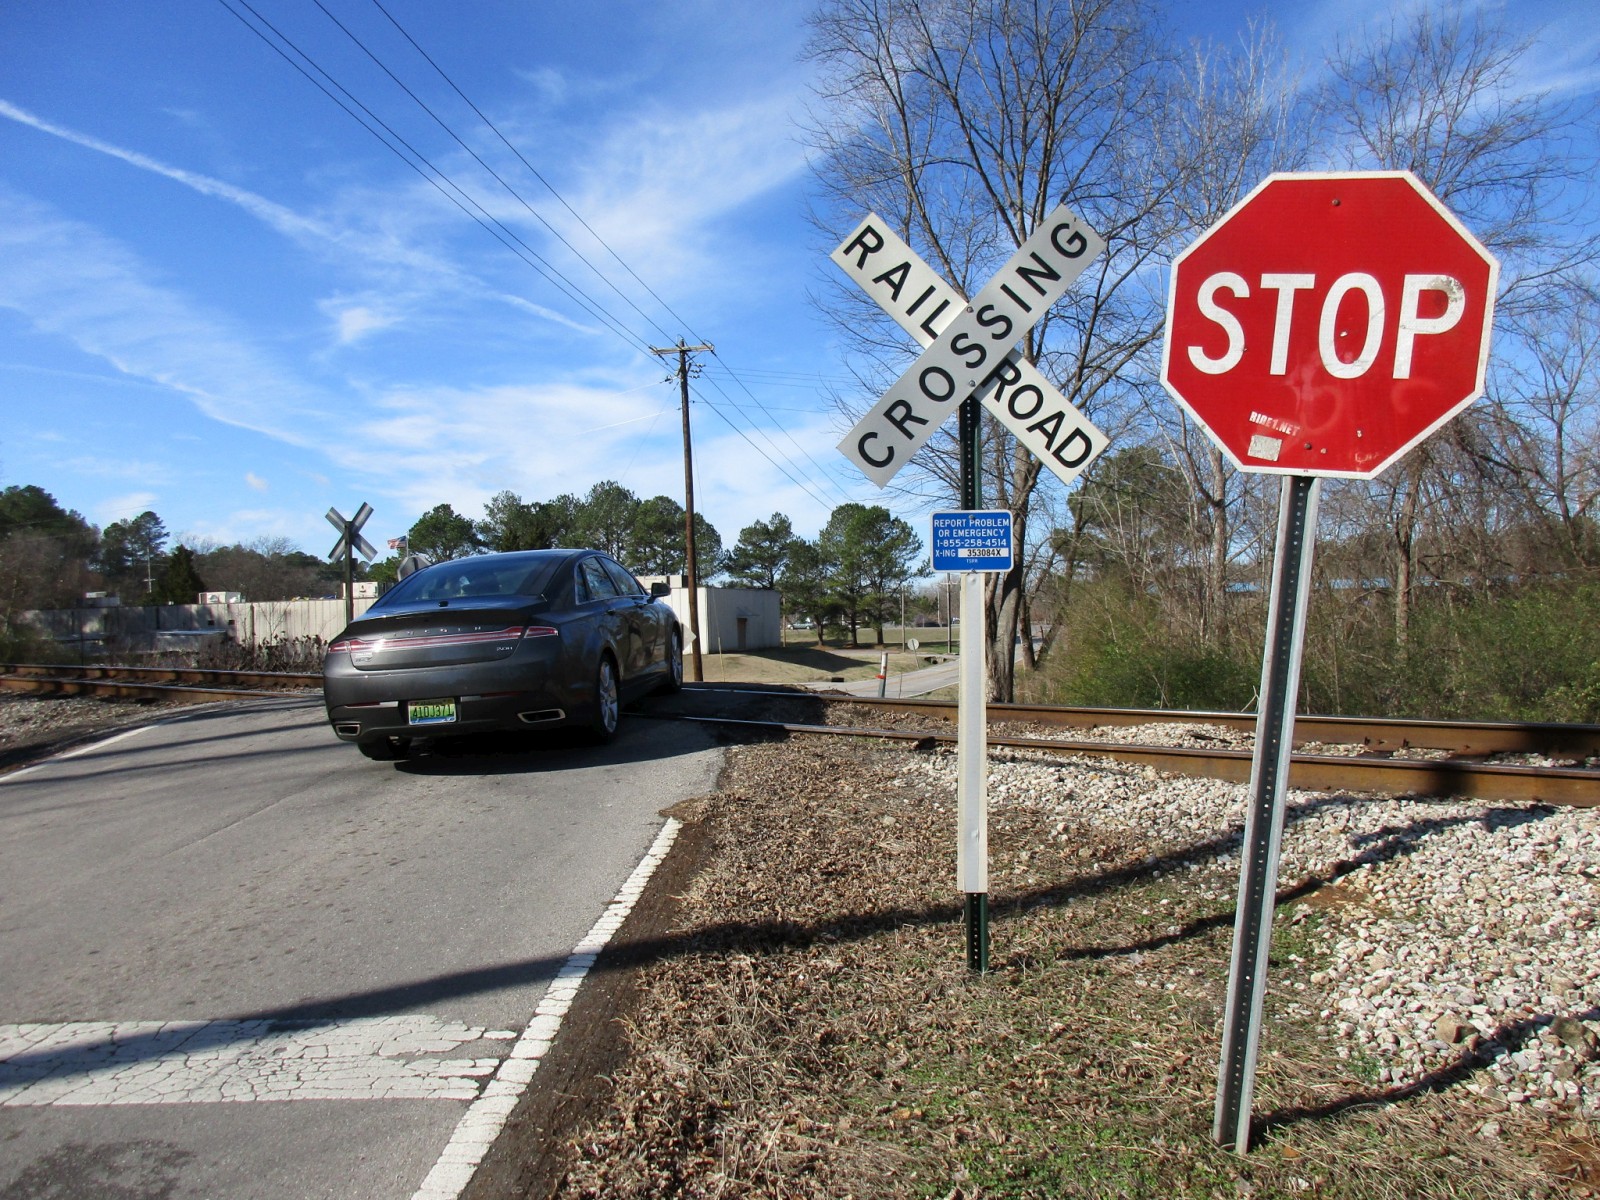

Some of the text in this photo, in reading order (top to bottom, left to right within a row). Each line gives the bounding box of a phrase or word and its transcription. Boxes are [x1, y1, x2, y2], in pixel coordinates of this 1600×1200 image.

[843, 225, 950, 340] RAIL
[858, 222, 1088, 468] CROSSING
[1187, 271, 1466, 380] STOP
[980, 357, 1093, 469] ROAD
[934, 518, 1009, 528] REPORT PROBLEM
[935, 548, 1001, 557] X-ING 353084X
[937, 538, 1007, 547] 1-855-258-4514
[938, 528, 1005, 537] OR EMERGENCY
